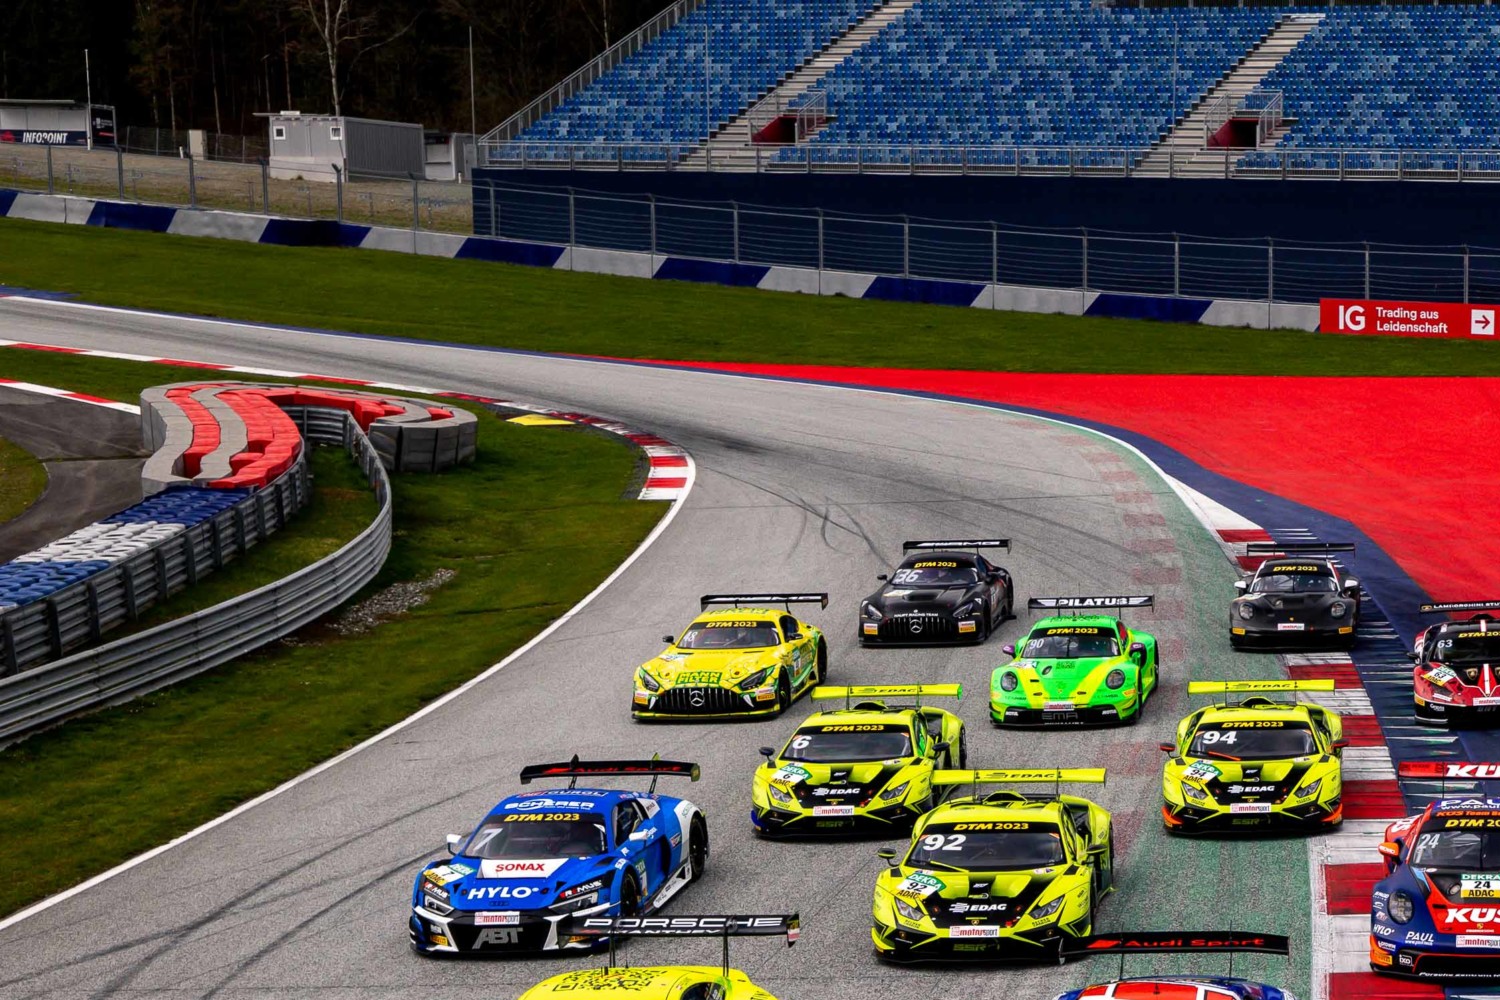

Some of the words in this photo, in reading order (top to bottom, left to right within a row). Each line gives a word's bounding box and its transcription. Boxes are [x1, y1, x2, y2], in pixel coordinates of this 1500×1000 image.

[23, 132, 67, 144] INFOPOINT
[1339, 305, 1365, 330] IG
[1376, 307, 1415, 321] Trading
[1419, 311, 1438, 320] aus
[1376, 320, 1448, 334] Leidenschaft
[1058, 598, 1128, 606] PILATUS
[1029, 639, 1044, 649] 90
[1438, 639, 1453, 648] 63
[792, 736, 812, 749] 6
[1202, 731, 1237, 744] 94
[504, 801, 594, 810] SCHERER
[504, 814, 544, 822] DTM
[545, 813, 580, 821] 2023
[1445, 819, 1484, 827] DTM
[954, 823, 993, 831] DTM
[474, 828, 502, 850] 7
[923, 834, 966, 850] 92
[1420, 834, 1439, 848] 24
[496, 863, 545, 872] SONAX
[1474, 881, 1491, 889] 24
[1468, 889, 1494, 897] ADAC
[584, 917, 783, 929] PORSCHE
[472, 928, 524, 949] ABT
[1125, 938, 1181, 947] Audi
[1191, 938, 1264, 947] Sport
